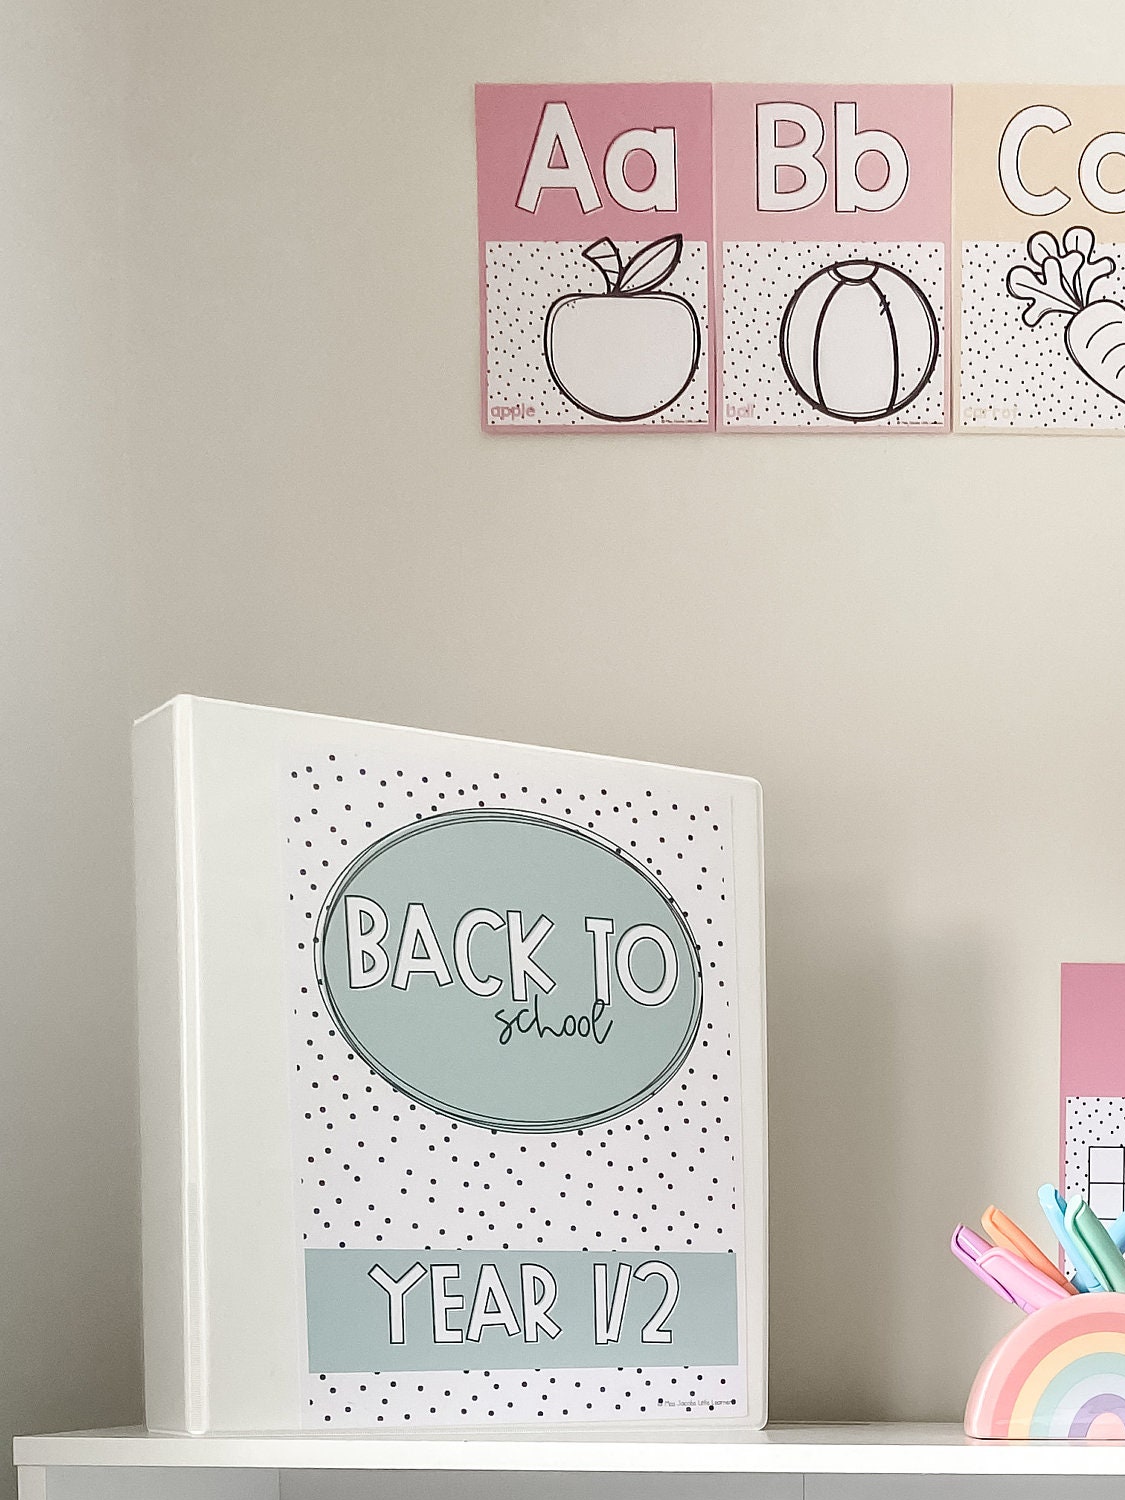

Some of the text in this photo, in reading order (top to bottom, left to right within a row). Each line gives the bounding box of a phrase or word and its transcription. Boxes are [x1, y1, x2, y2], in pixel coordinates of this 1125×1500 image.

[514, 101, 678, 214] Aa
[755, 101, 909, 213] Bb
[490, 402, 536, 421] apple
[344, 895, 678, 1007] BACK TO
[495, 994, 613, 1045] school
[367, 1261, 562, 1345] YEAR
